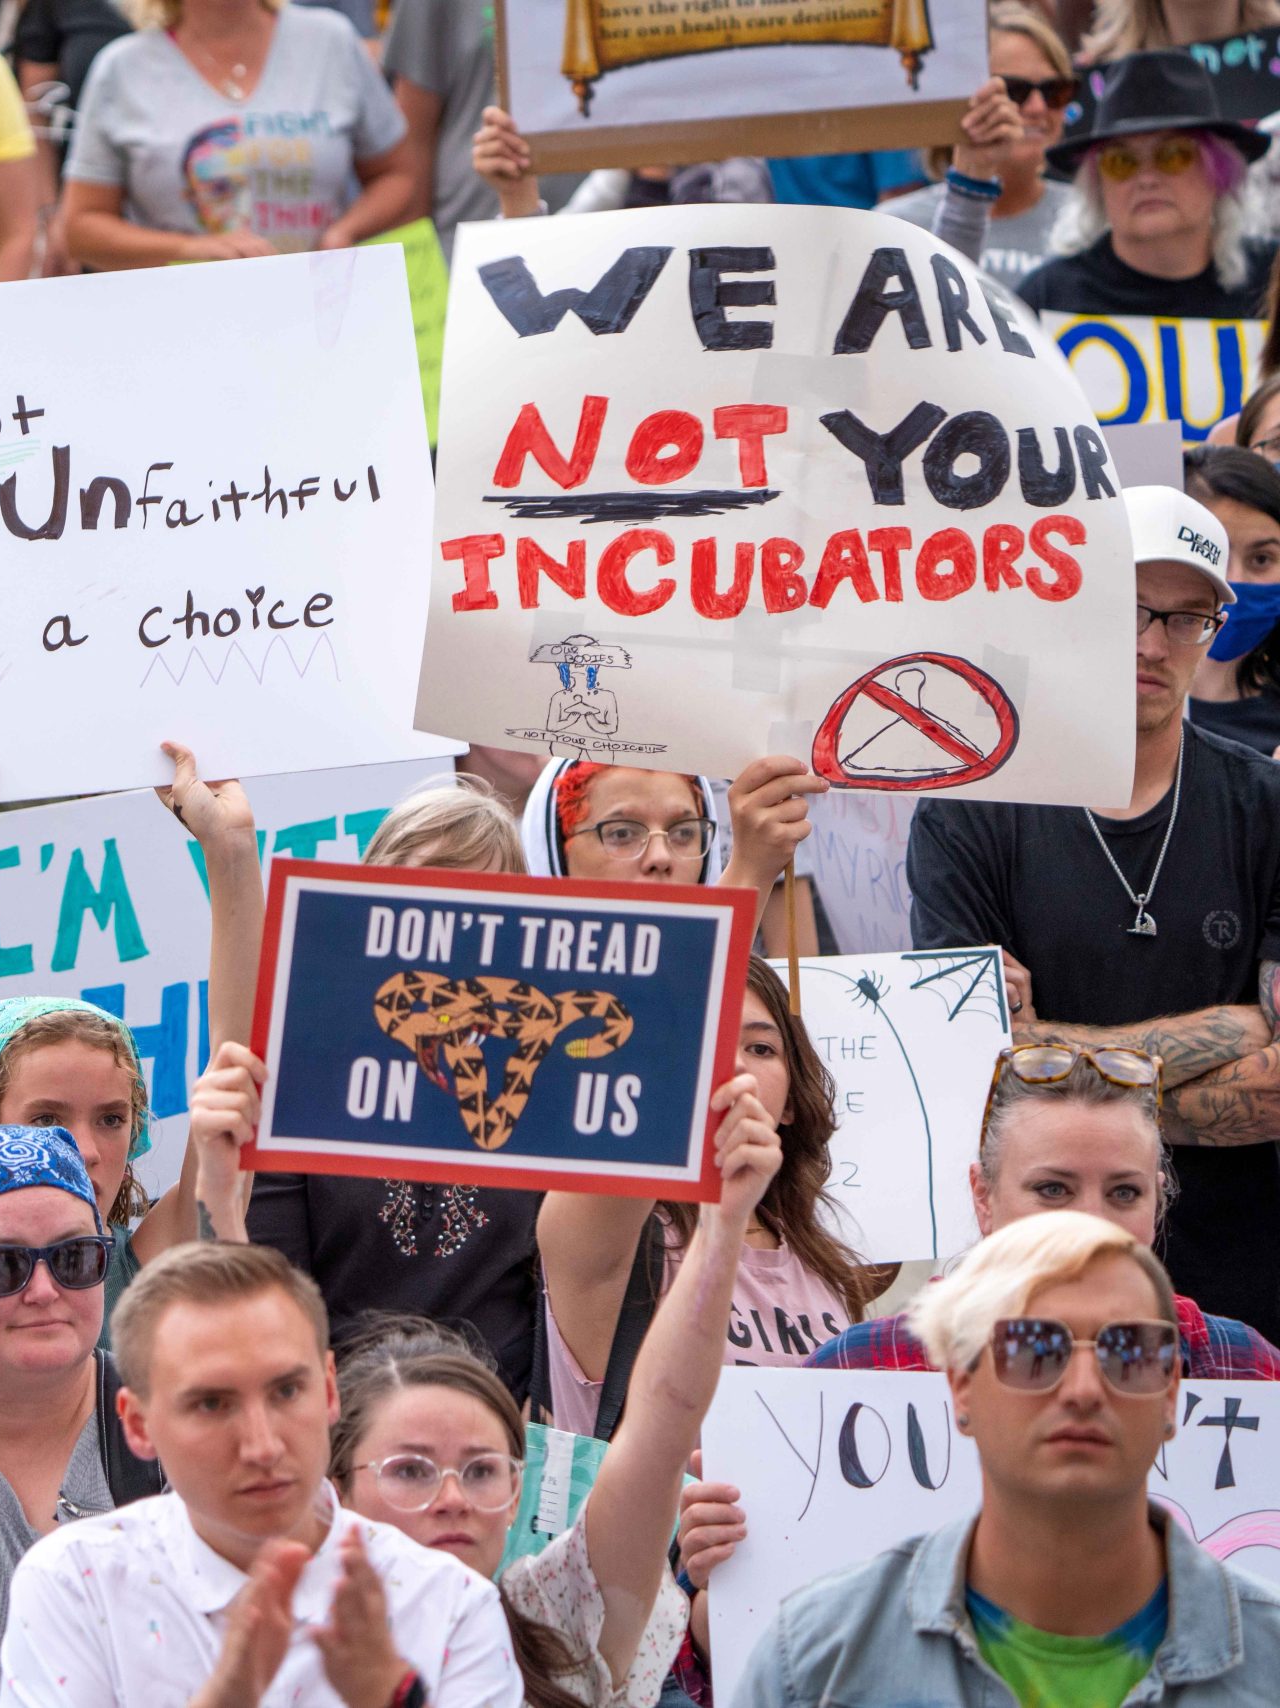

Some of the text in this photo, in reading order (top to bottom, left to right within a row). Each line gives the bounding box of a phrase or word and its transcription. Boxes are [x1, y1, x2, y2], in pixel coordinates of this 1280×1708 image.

[477, 246, 777, 352] WE
[832, 246, 1036, 359] ARE
[493, 394, 1119, 507] NOT YOUR
[441, 515, 1089, 620] INCUBATORS
[42, 611, 89, 652] a
[138, 585, 335, 648] choice
[565, 653, 614, 665] BODIES
[524, 731, 546, 739] NOT
[552, 733, 586, 746] YOUR
[365, 905, 661, 977] DON'T TREAD
[818, 1036, 878, 1062] THE
[346, 1056, 642, 1137] ON US
